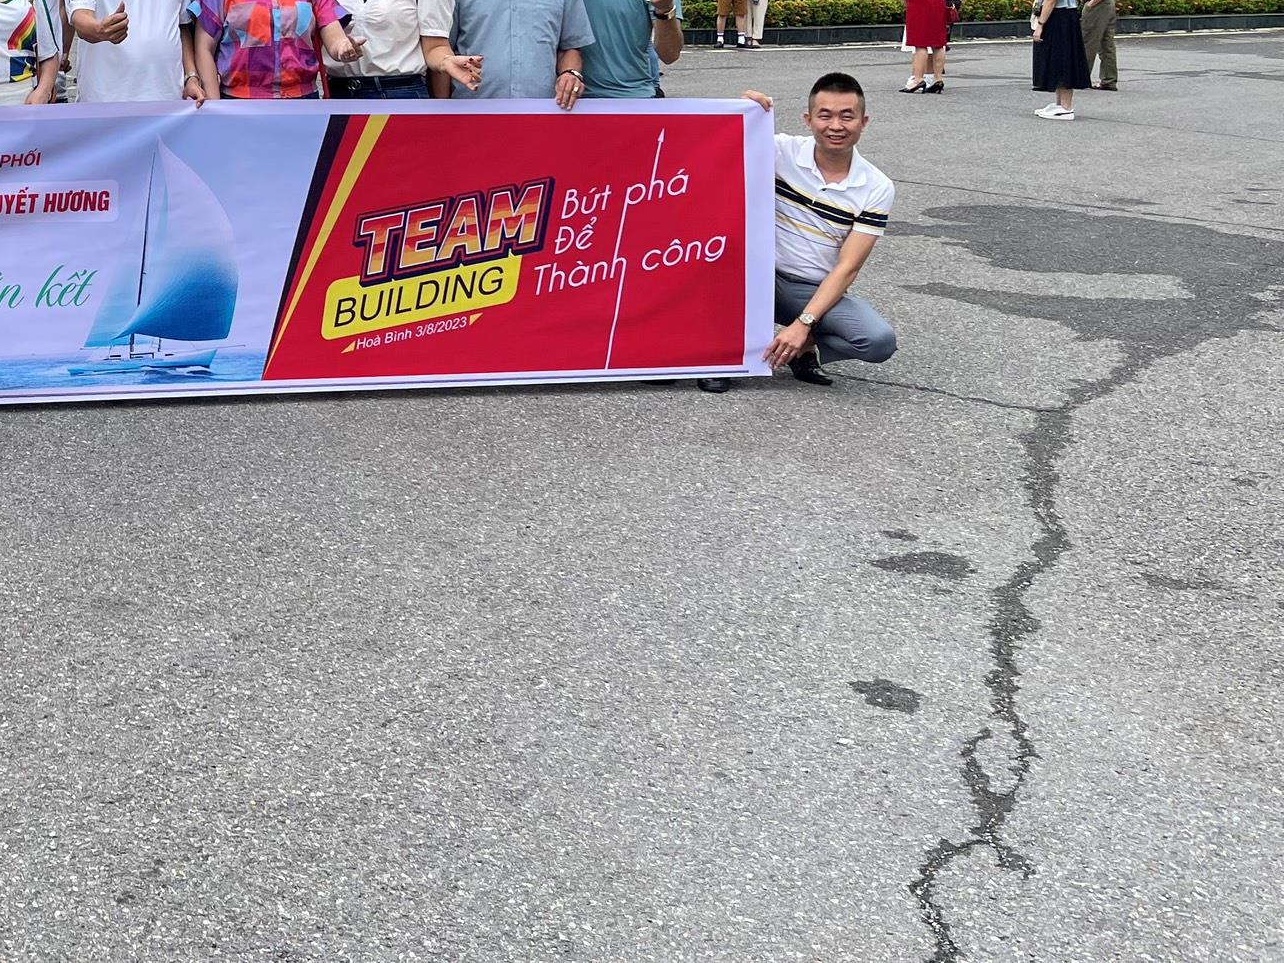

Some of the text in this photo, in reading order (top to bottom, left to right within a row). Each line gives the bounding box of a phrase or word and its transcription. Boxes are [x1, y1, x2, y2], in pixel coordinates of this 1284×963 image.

[0, 147, 42, 169] PHỐI
[43, 188, 110, 214] HƯƠNG
[561, 184, 612, 220] Bứt
[356, 179, 550, 283] TEAM
[554, 216, 598, 255] Để
[34, 264, 99, 309] kết
[534, 235, 727, 299] Thành công
[333, 265, 504, 328] BUILDING
[356, 335, 381, 351] Hoà
[415, 316, 468, 338] 3/8/2023
